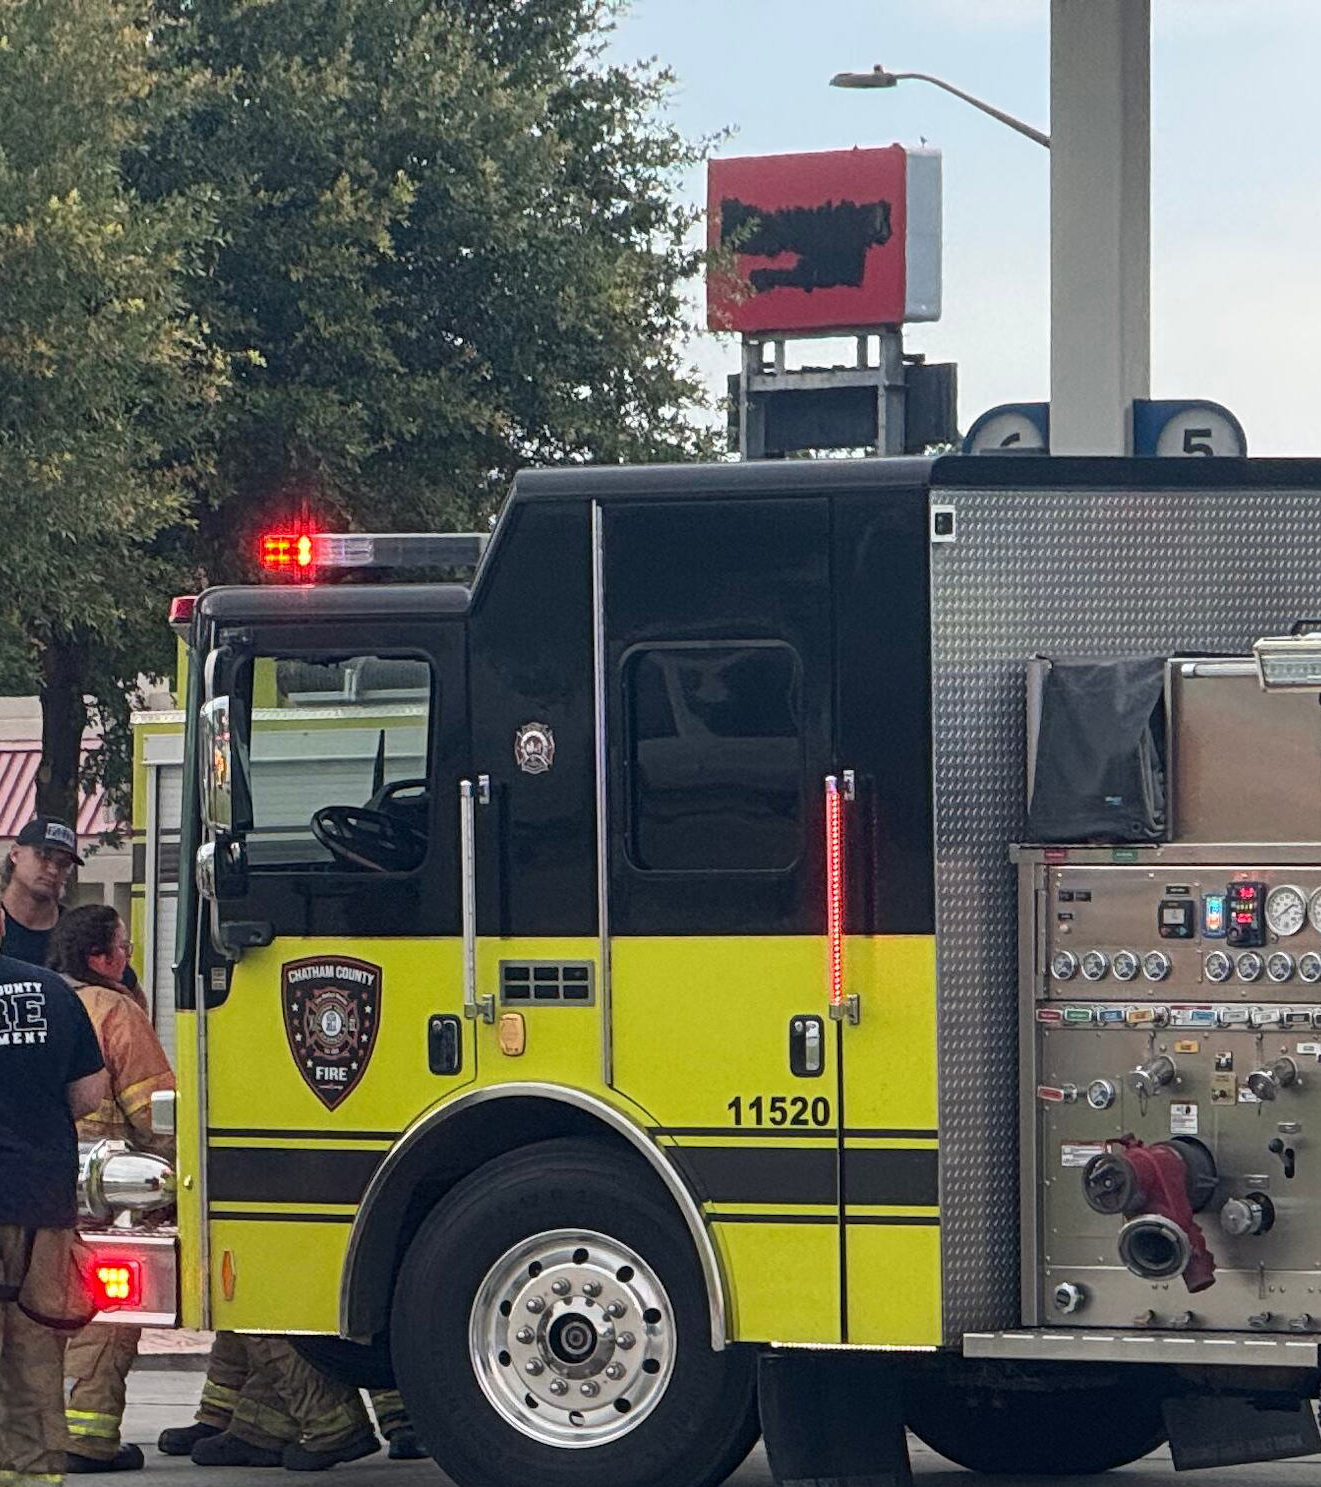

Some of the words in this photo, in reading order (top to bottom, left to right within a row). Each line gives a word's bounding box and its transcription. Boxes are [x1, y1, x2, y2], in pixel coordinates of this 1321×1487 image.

[288, 966, 334, 984] CHATHAM
[336, 966, 375, 986] COUNTY
[315, 1066, 349, 1082] FIRE
[727, 1096, 831, 1126] 11520
